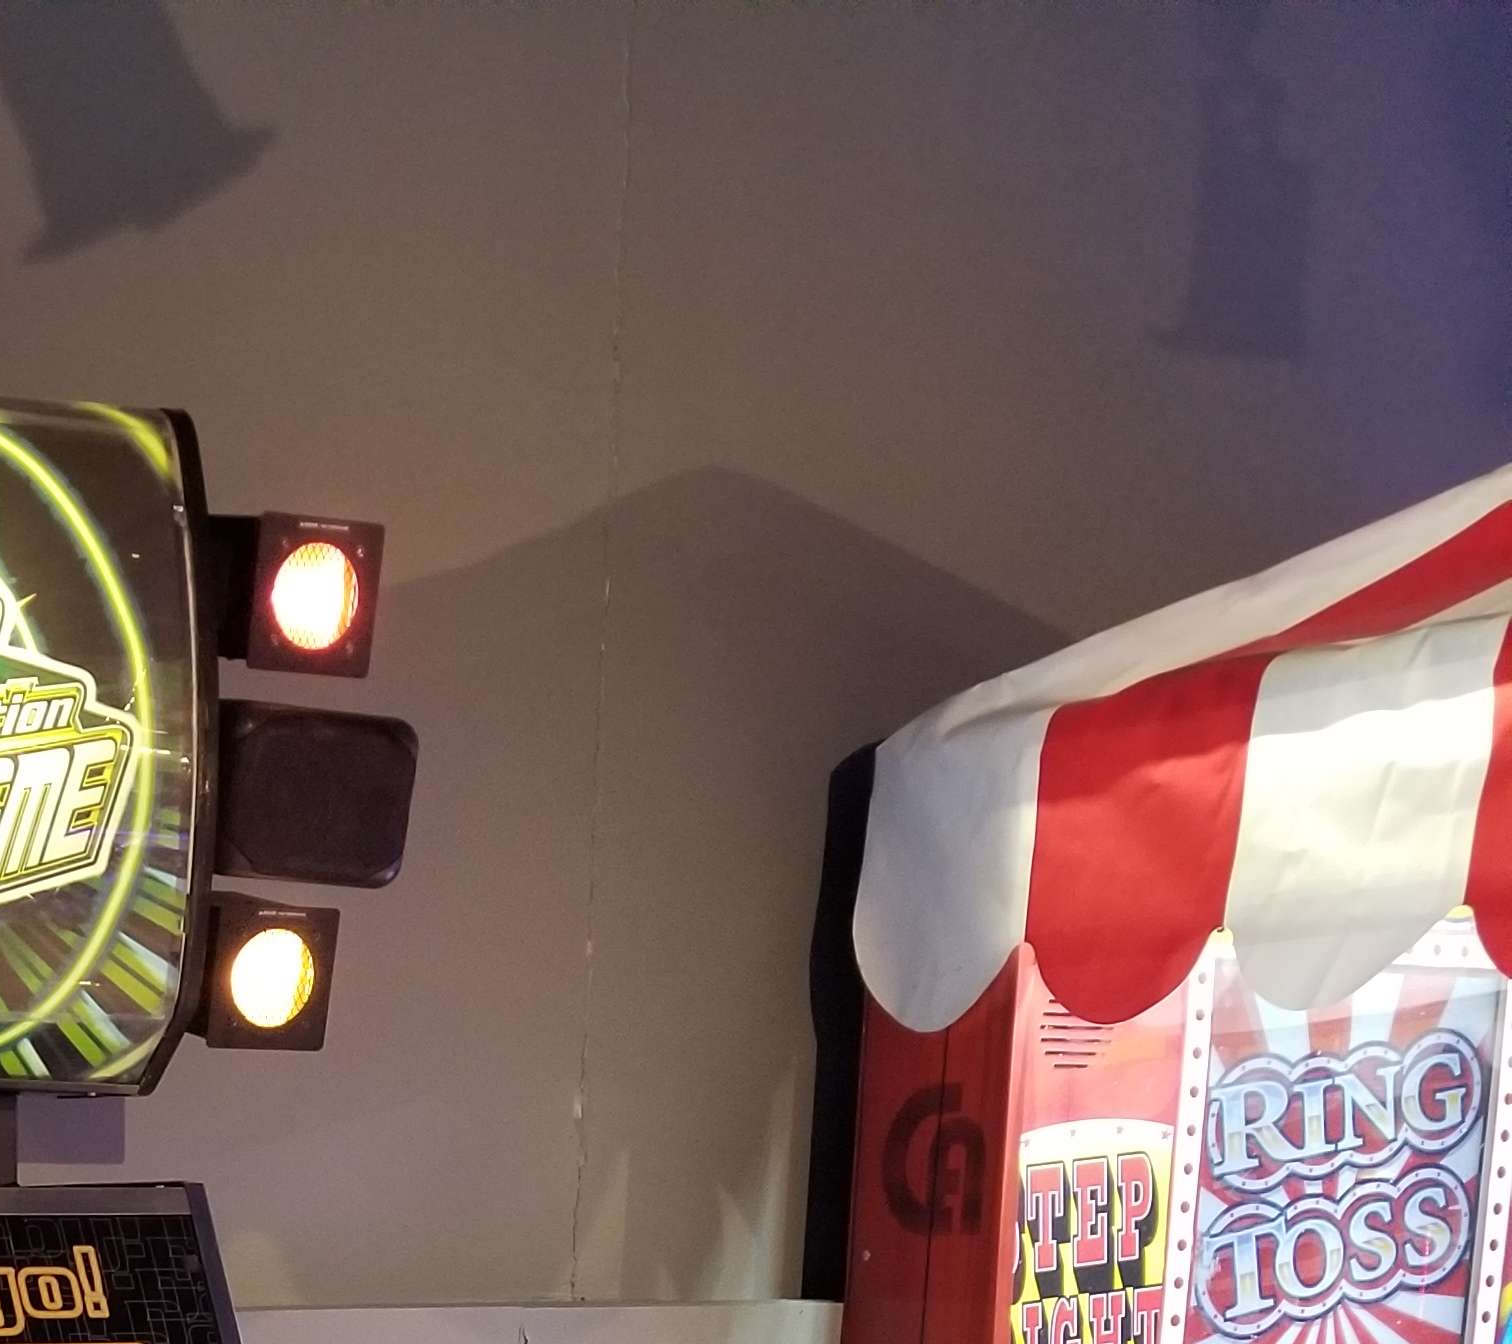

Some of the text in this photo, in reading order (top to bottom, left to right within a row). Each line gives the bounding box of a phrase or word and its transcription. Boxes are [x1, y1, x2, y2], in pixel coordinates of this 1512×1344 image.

[1208, 1052, 1468, 1180] RING
[1012, 1152, 1154, 1274] TEP
[1201, 1187, 1453, 1323] TOSS
